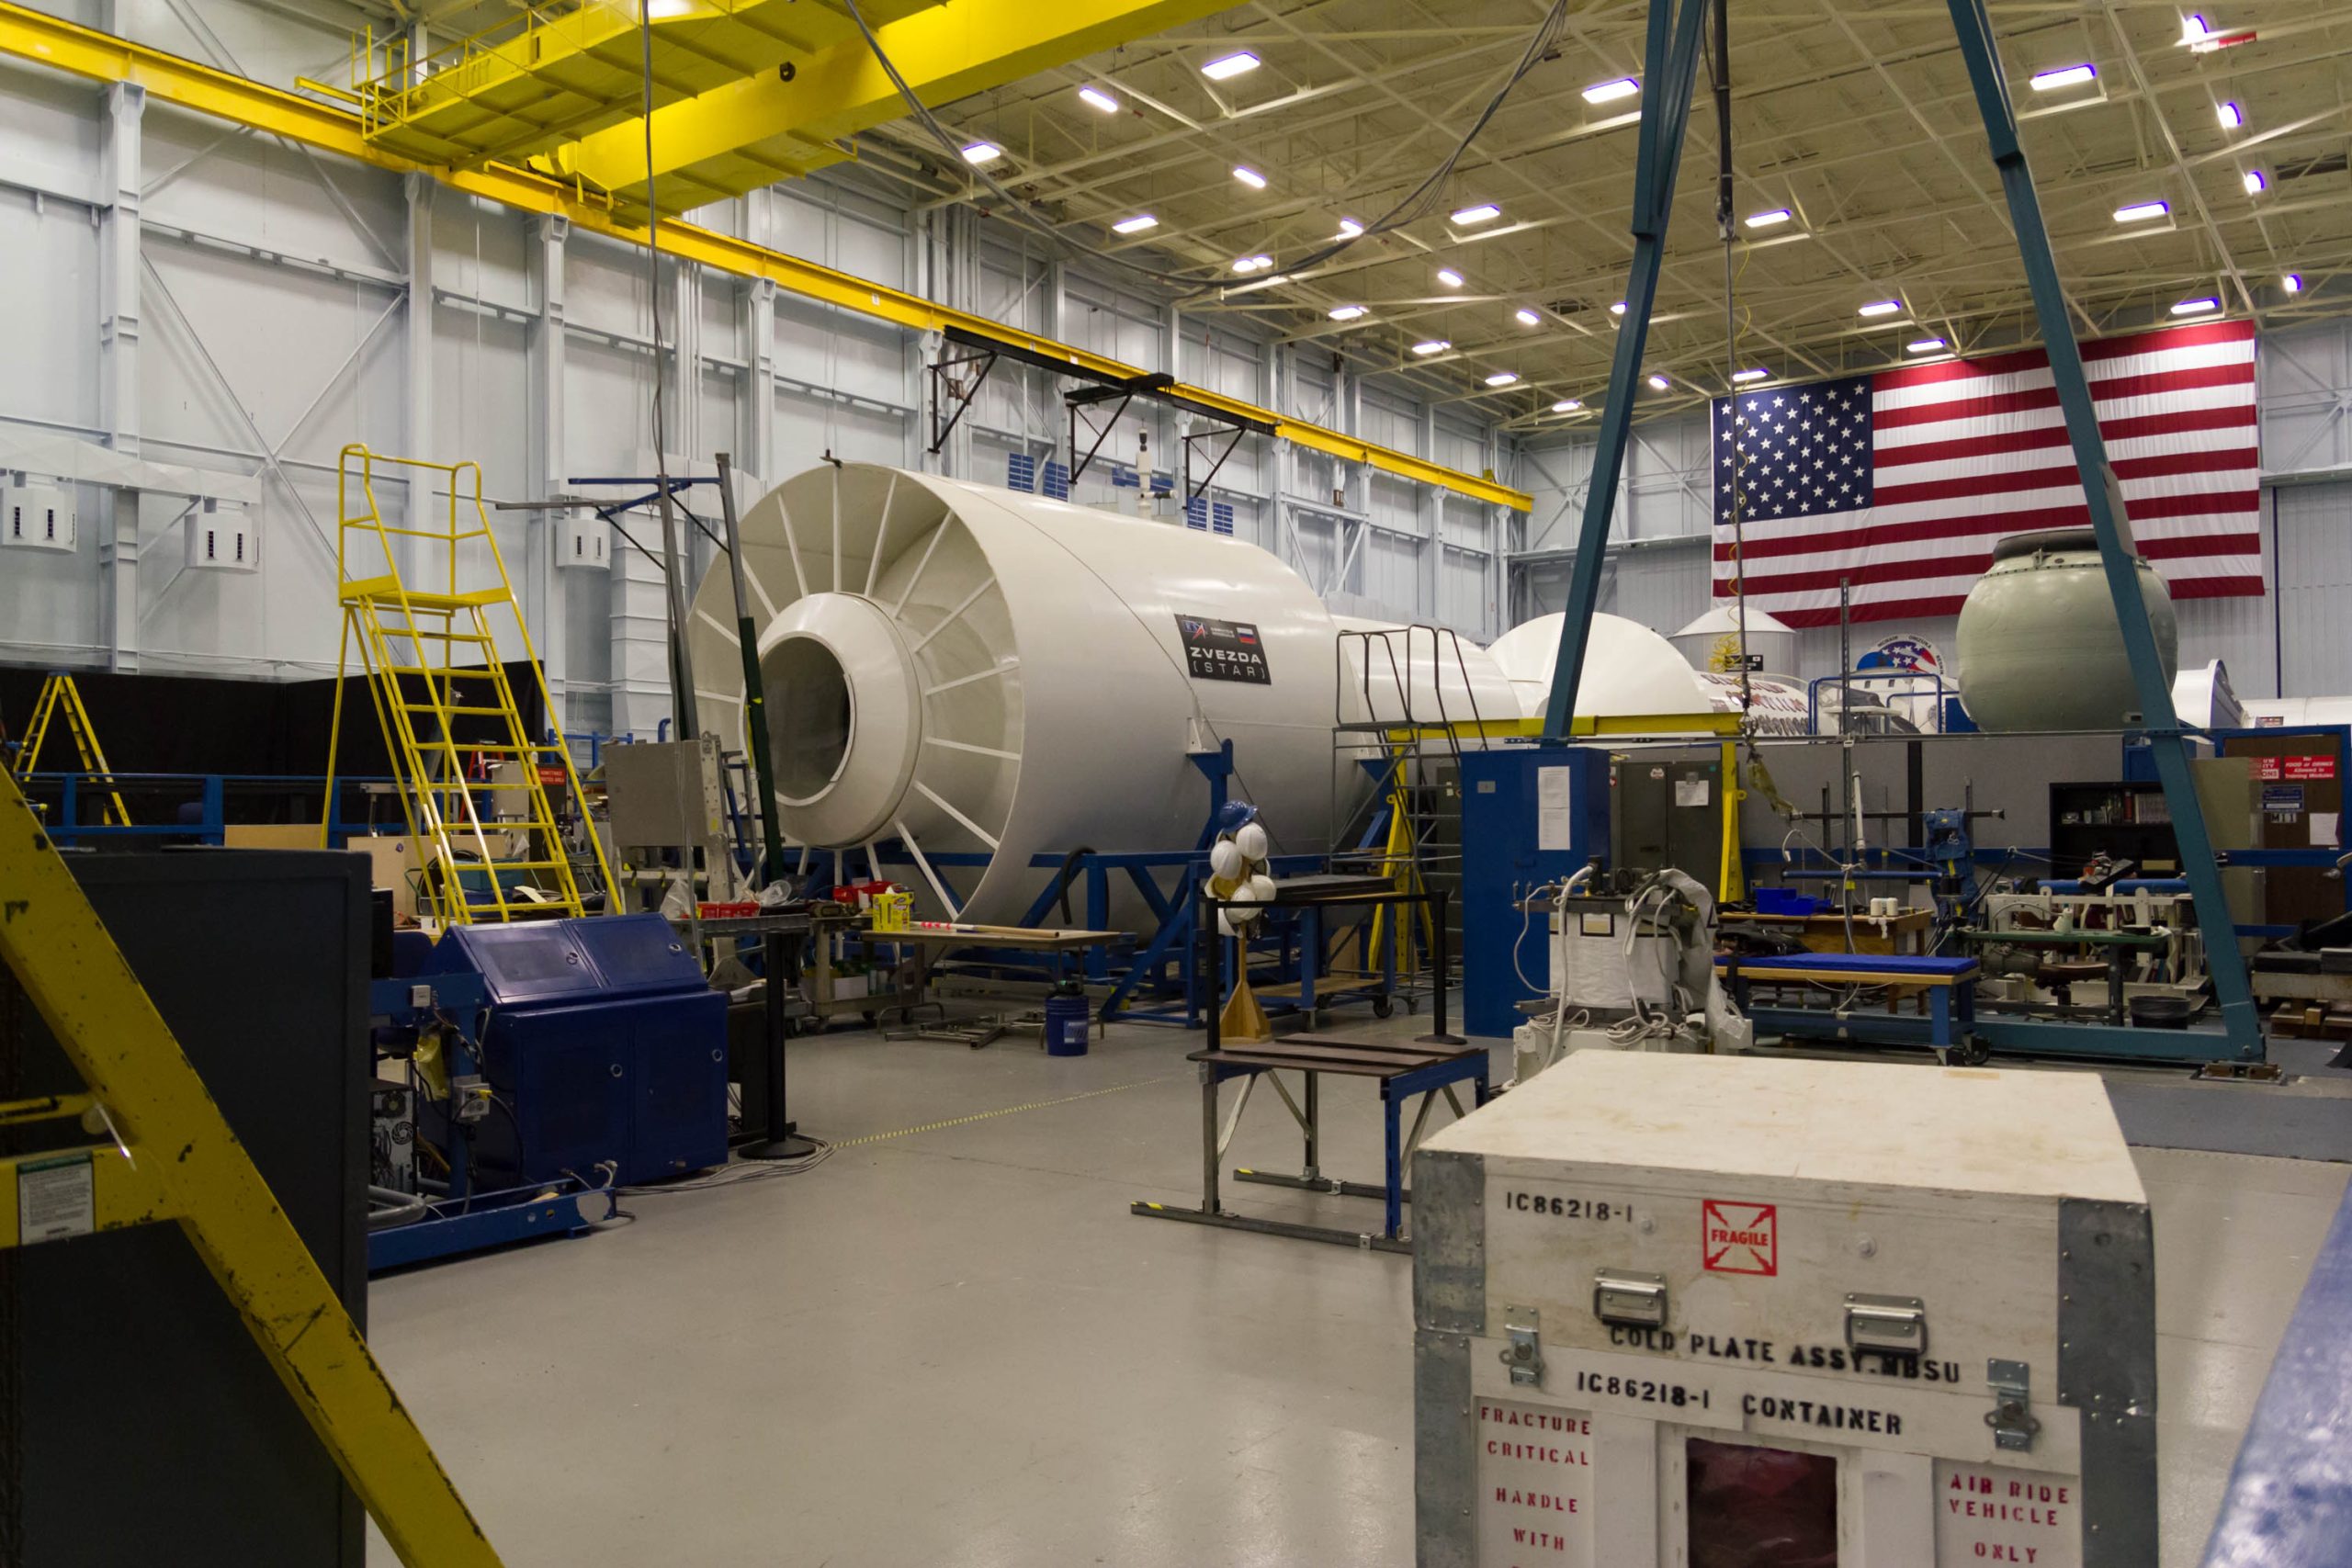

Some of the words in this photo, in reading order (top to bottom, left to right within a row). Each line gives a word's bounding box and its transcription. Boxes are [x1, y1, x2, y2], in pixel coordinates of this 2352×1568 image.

[1190, 647, 1262, 664] ZVEZDA
[1712, 1229, 1769, 1247] FRAGILE
[1610, 1326, 1676, 1351] COLD
[1690, 1334, 1775, 1362] PLATE
[1480, 1406, 1590, 1435] FRACTURE
[1742, 1394, 1902, 1435] CONTAINER
[1487, 1440, 1589, 1466] CRITICAL
[1496, 1487, 1577, 1513] HANDLE
[1950, 1473, 1994, 1495] AIR
[2008, 1481, 2069, 1504] RIDE
[1949, 1498, 2058, 1526] VEHICLE
[1513, 1529, 1565, 1551] WITH
[1974, 1541, 2038, 1563] ONLY
